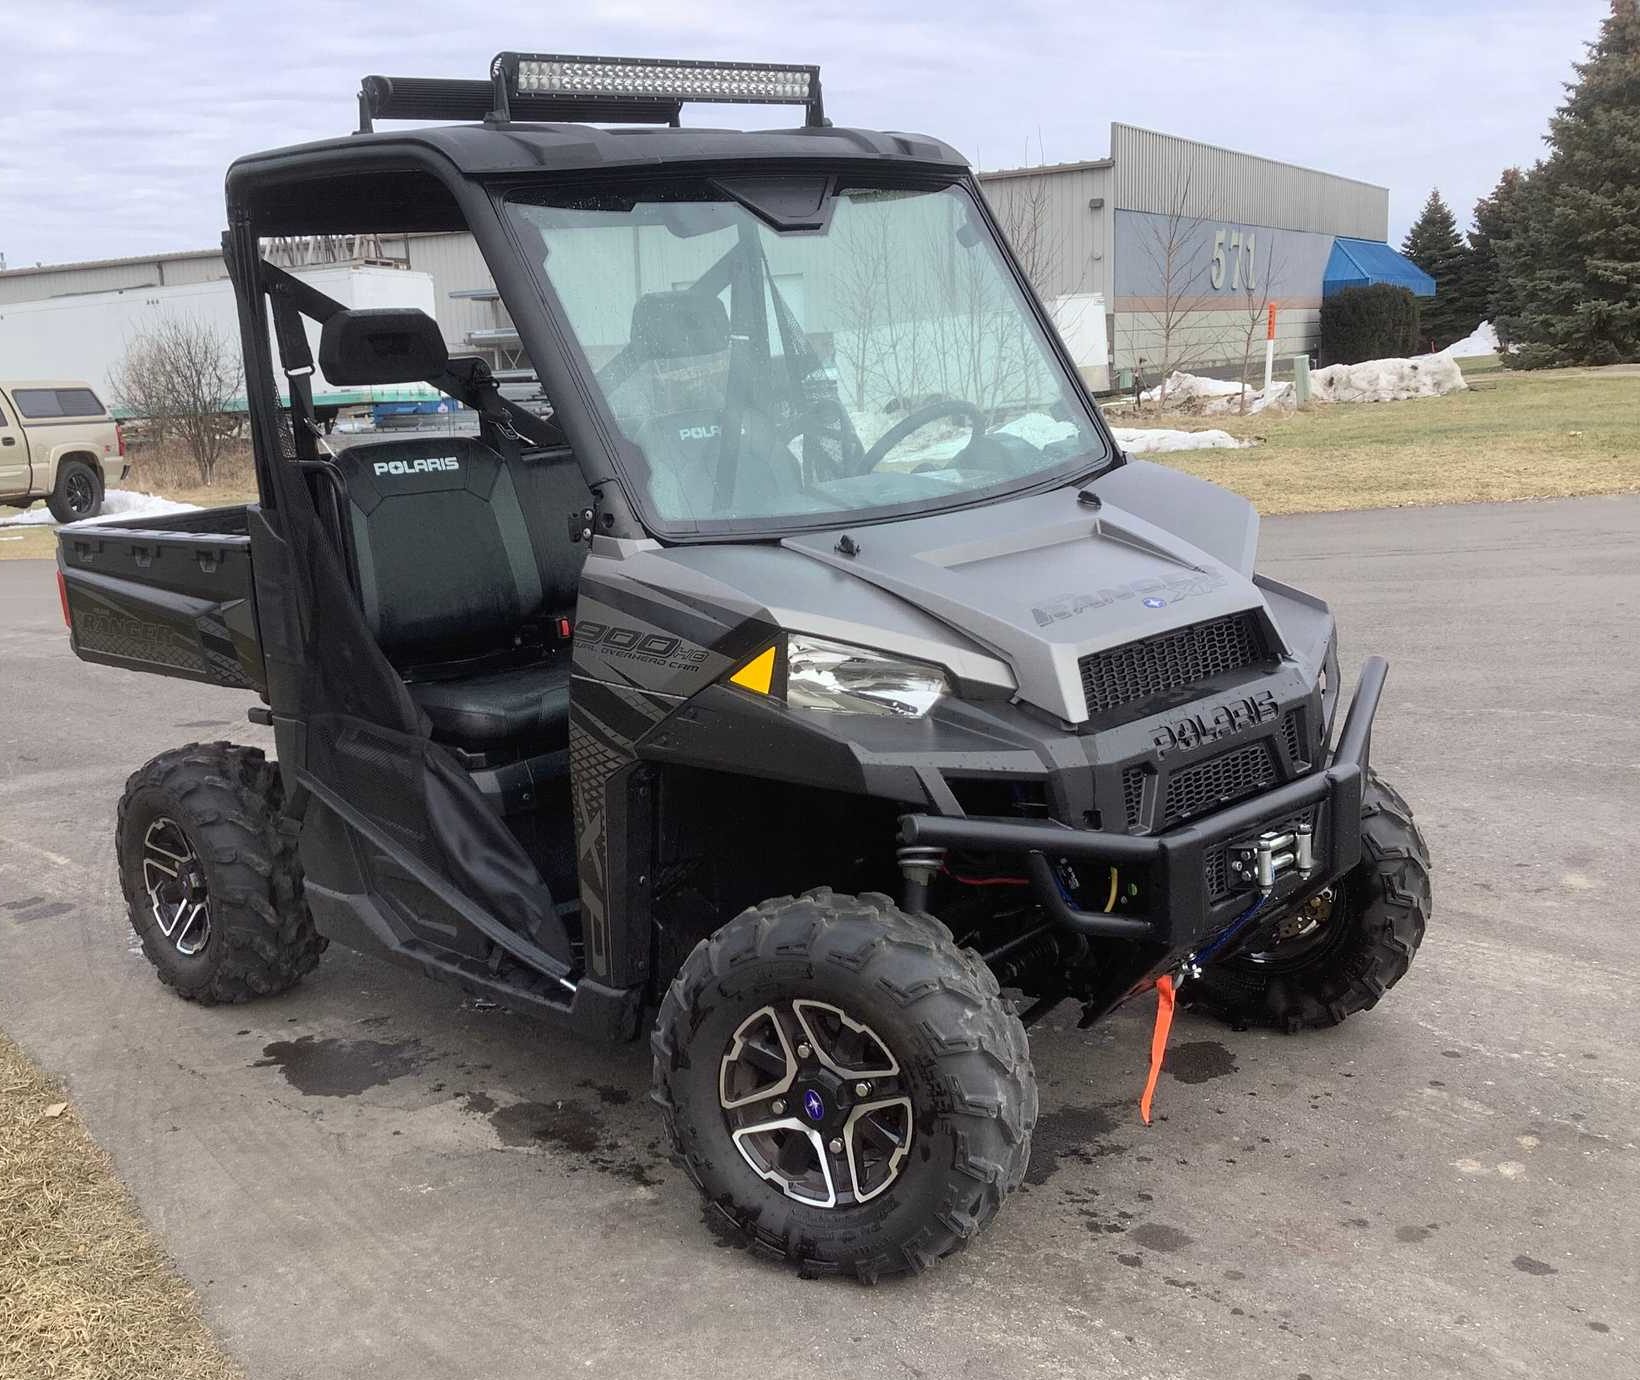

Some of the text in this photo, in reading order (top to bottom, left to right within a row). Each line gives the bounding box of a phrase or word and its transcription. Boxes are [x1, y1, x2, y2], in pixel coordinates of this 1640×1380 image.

[1211, 229, 1257, 291] 571
[373, 456, 460, 476] POLARIS
[668, 661, 700, 673] CAM
[1148, 690, 1279, 760] POLARIS
